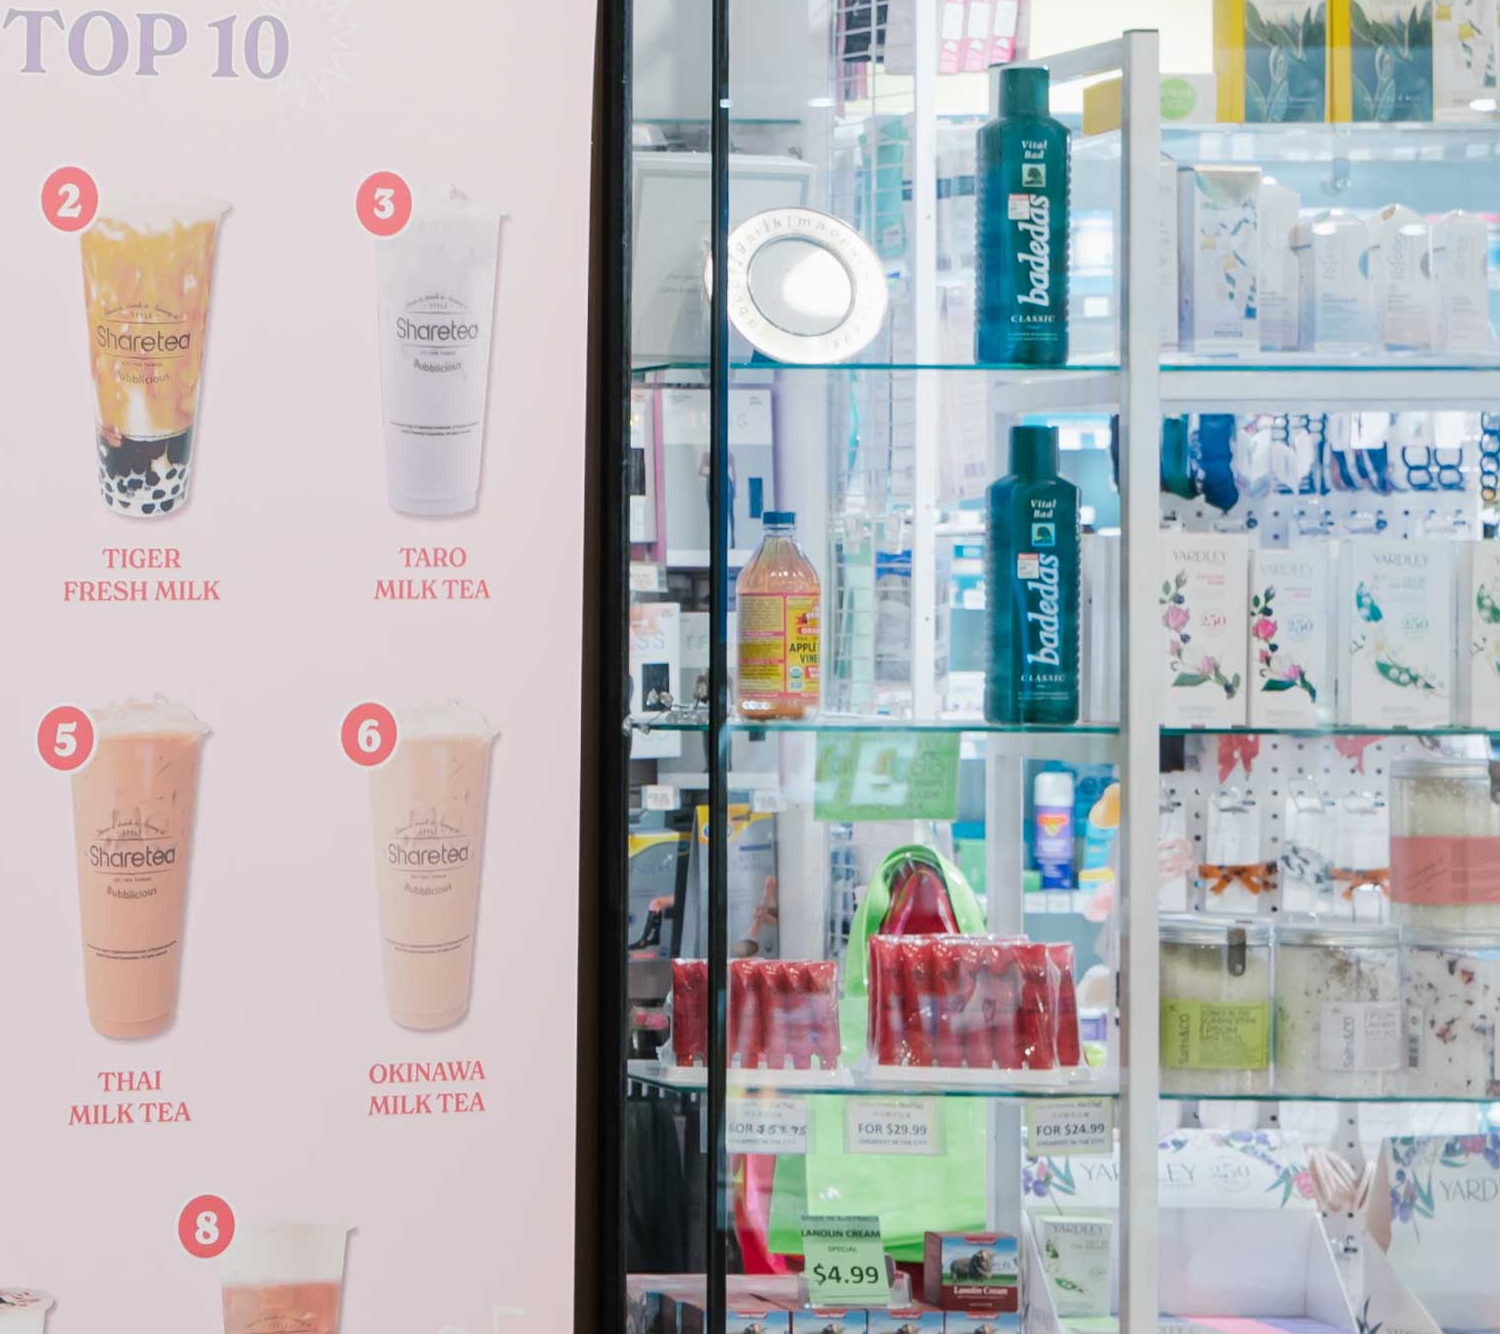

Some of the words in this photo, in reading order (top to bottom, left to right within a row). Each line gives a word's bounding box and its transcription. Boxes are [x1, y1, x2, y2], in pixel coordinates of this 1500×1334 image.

[2, 6, 189, 78] TOP
[209, 13, 290, 80] 10
[1022, 140, 1048, 149] Vital
[1025, 150, 1044, 159] Bad
[57, 182, 82, 219] 2
[373, 187, 395, 219] 3
[1017, 194, 1050, 306] badedas
[396, 317, 479, 341] Sharetea
[1011, 315, 1055, 323] CLASSIC
[96, 324, 192, 352] Sharetea
[1031, 499, 1057, 508] Vital
[1033, 509, 1054, 518] Bad
[102, 547, 181, 571] TIGER
[400, 547, 468, 569] TARO
[1172, 550, 1228, 563] YARDLEY
[1372, 553, 1429, 566] YARDLEY
[64, 580, 147, 603] FRESH
[155, 580, 220, 602] MILK
[376, 579, 437, 601] MILK
[441, 578, 490, 601] TEA
[1027, 554, 1060, 666] badedas
[789, 642, 816, 652] APPLE
[1020, 674, 1065, 683] CLASSIC
[54, 722, 77, 756] 5
[357, 718, 381, 753] 6
[89, 842, 176, 869] Sharetea
[387, 842, 469, 867] Sharetea
[106, 886, 158, 900] Bubblicious
[98, 1070, 161, 1093] THAI
[368, 1060, 486, 1085] OKINAWA
[70, 1103, 134, 1126] MILK
[139, 1101, 191, 1123] TEA
[368, 1094, 431, 1115] MILK
[435, 1092, 485, 1114] TEA
[858, 1123, 883, 1134] FOR
[887, 1123, 927, 1136] $29.99
[1036, 1125, 1061, 1136] FOR
[1065, 1123, 1105, 1136] $24.99
[195, 1210, 220, 1245] 8
[801, 1229, 844, 1238] LANOLIN
[846, 1229, 881, 1239] CREAM
[813, 1263, 879, 1286] $4.99
